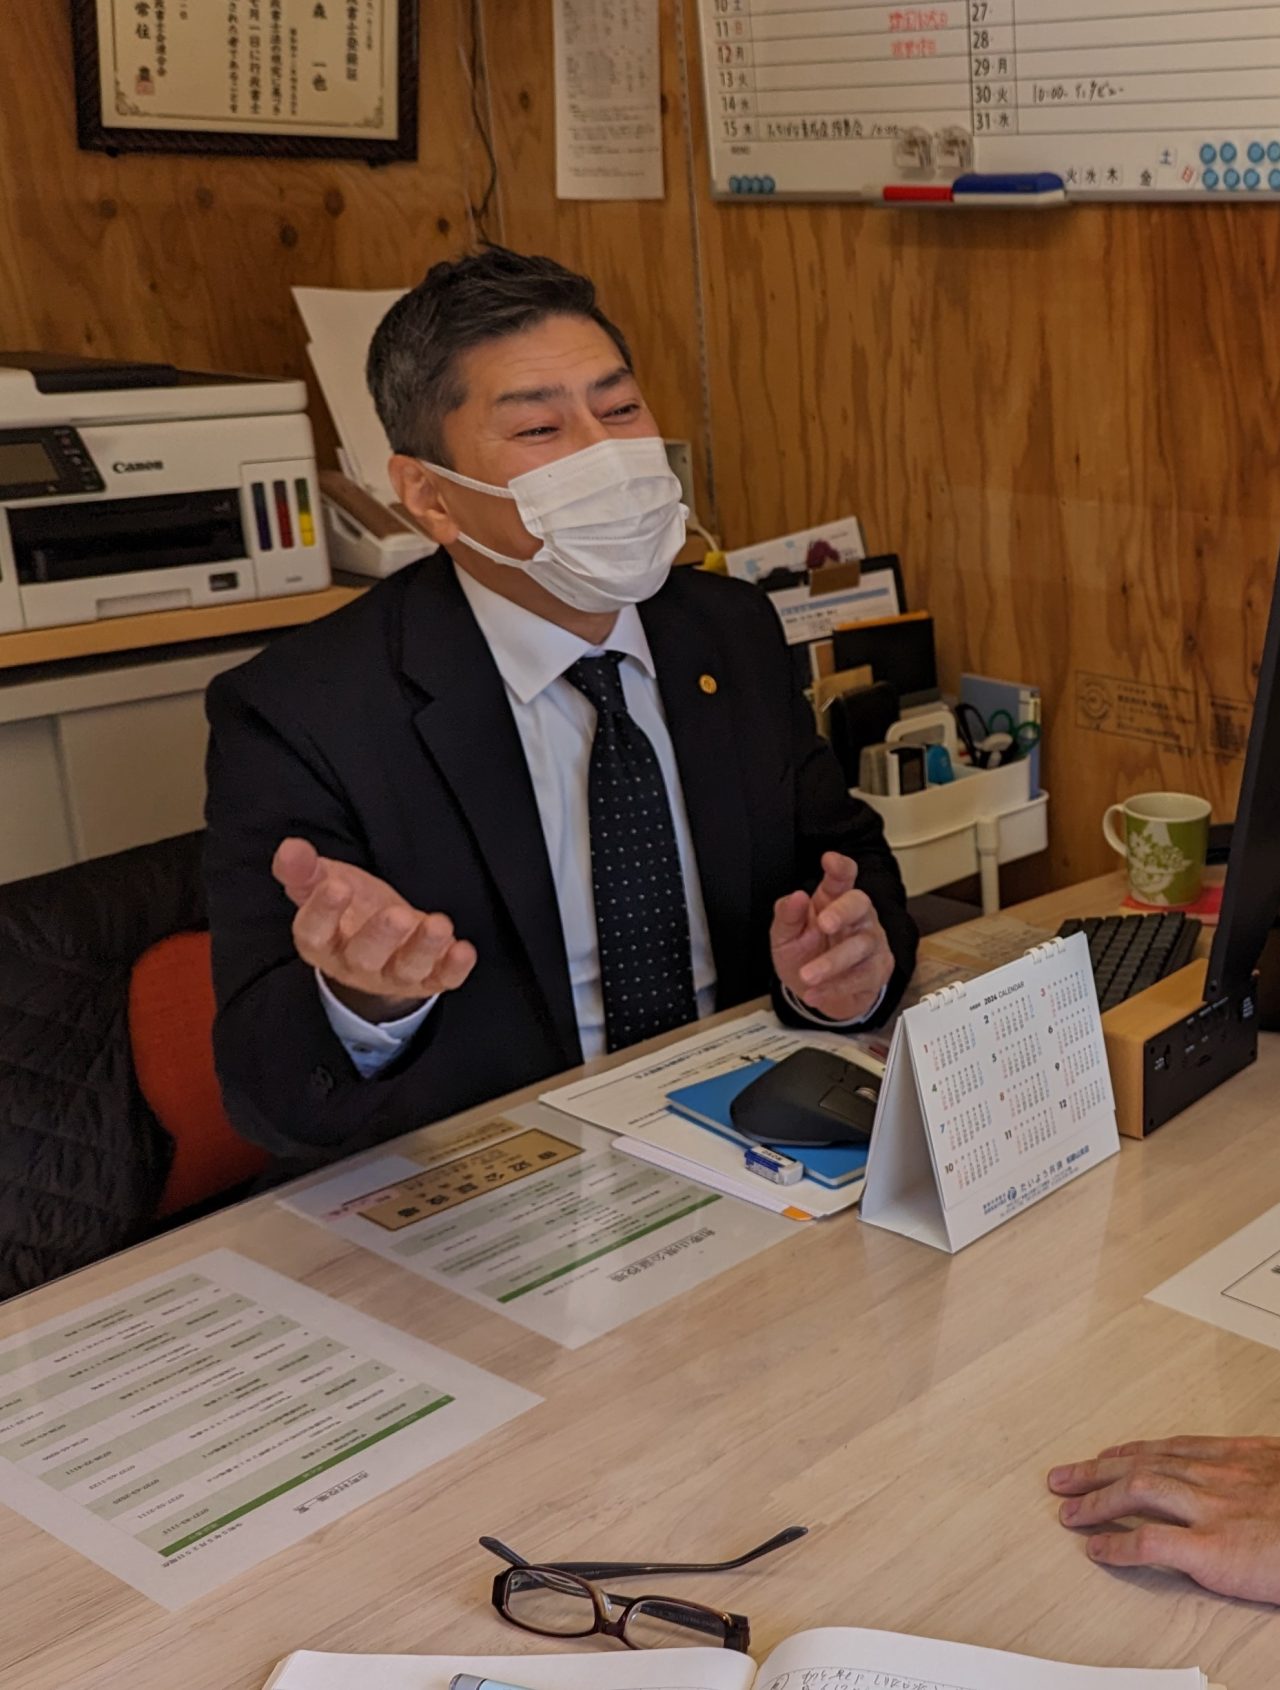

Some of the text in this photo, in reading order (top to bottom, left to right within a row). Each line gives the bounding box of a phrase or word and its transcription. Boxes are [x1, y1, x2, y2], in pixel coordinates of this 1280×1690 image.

[971, 3, 988, 22] 27
[716, 21, 729, 37] 11
[973, 30, 989, 49] 28
[718, 46, 732, 64] 12
[974, 58, 1008, 76] 29 月
[720, 72, 734, 87] 13
[975, 85, 1008, 103] 30 火
[722, 97, 736, 111] 14
[724, 121, 738, 137] 15
[976, 112, 991, 130] 31
[1159, 149, 1172, 165] 土
[1066, 168, 1078, 183] 火
[1086, 168, 1097, 183] 水
[1106, 168, 1119, 183] 木
[1140, 169, 1153, 186] 金
[112, 460, 164, 474] Canon
[984, 995, 998, 1006] 2024
